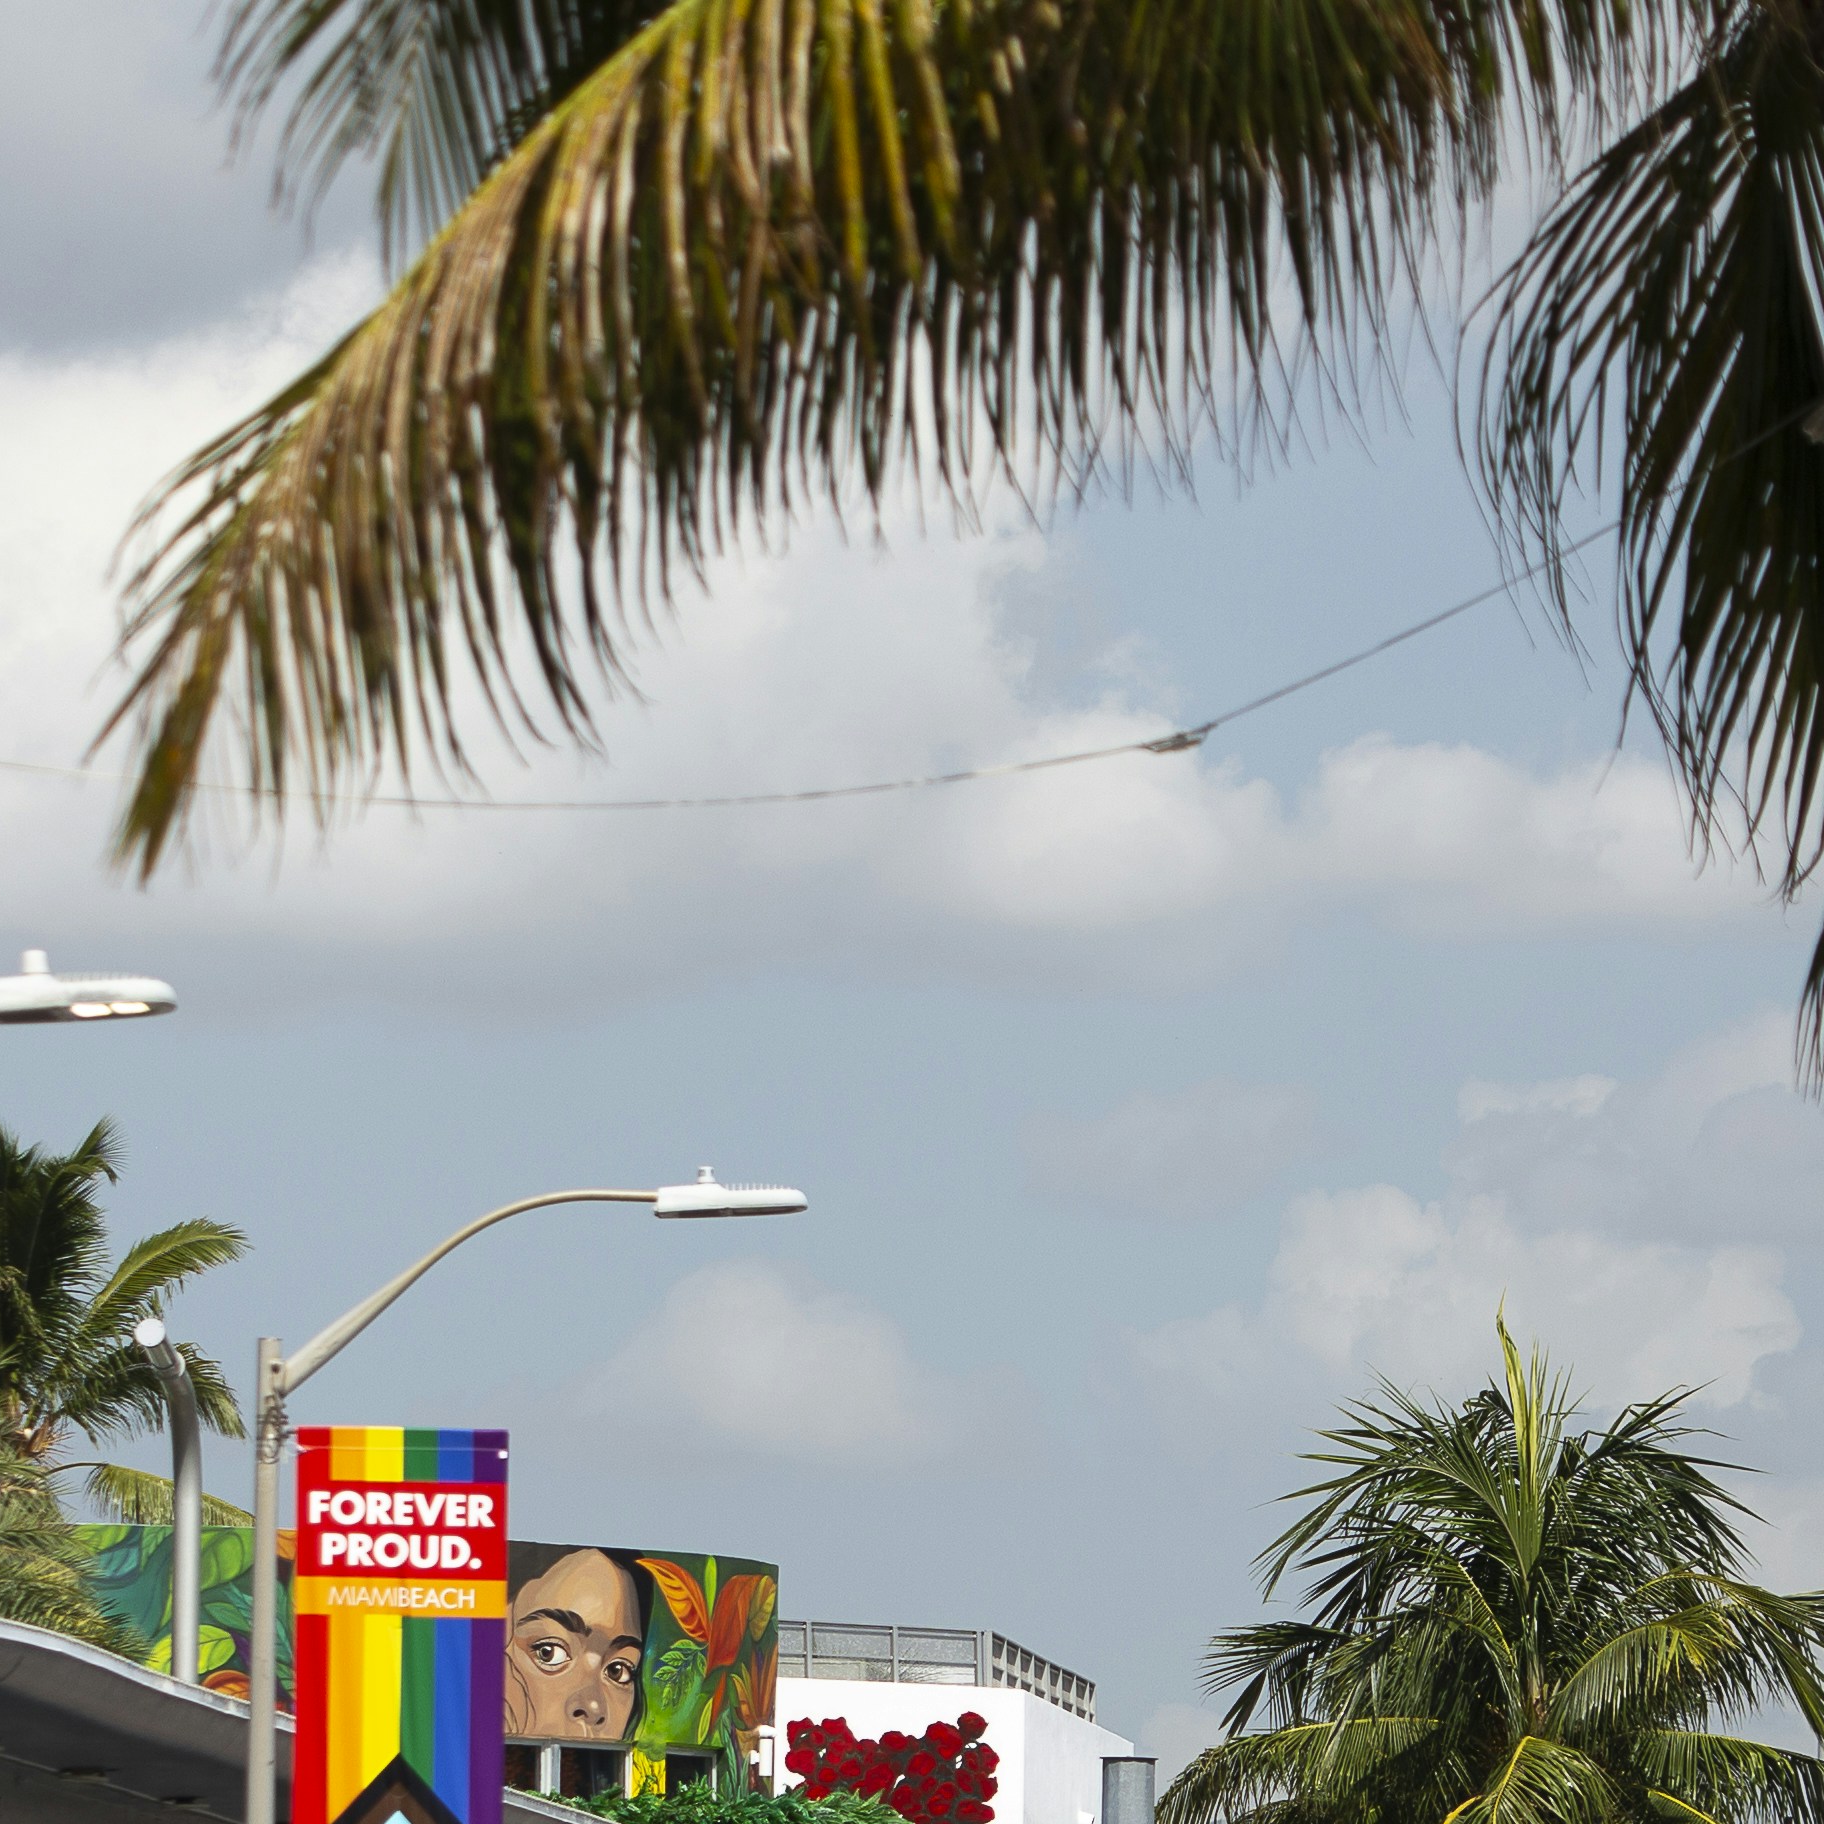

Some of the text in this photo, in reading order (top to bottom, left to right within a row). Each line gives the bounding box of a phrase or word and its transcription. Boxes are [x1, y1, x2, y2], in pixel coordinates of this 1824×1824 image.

[308, 1490, 495, 1527] FOREVER
[320, 1532, 482, 1569] PROUD.
[327, 1586, 475, 1609] MIAMIBEACH
